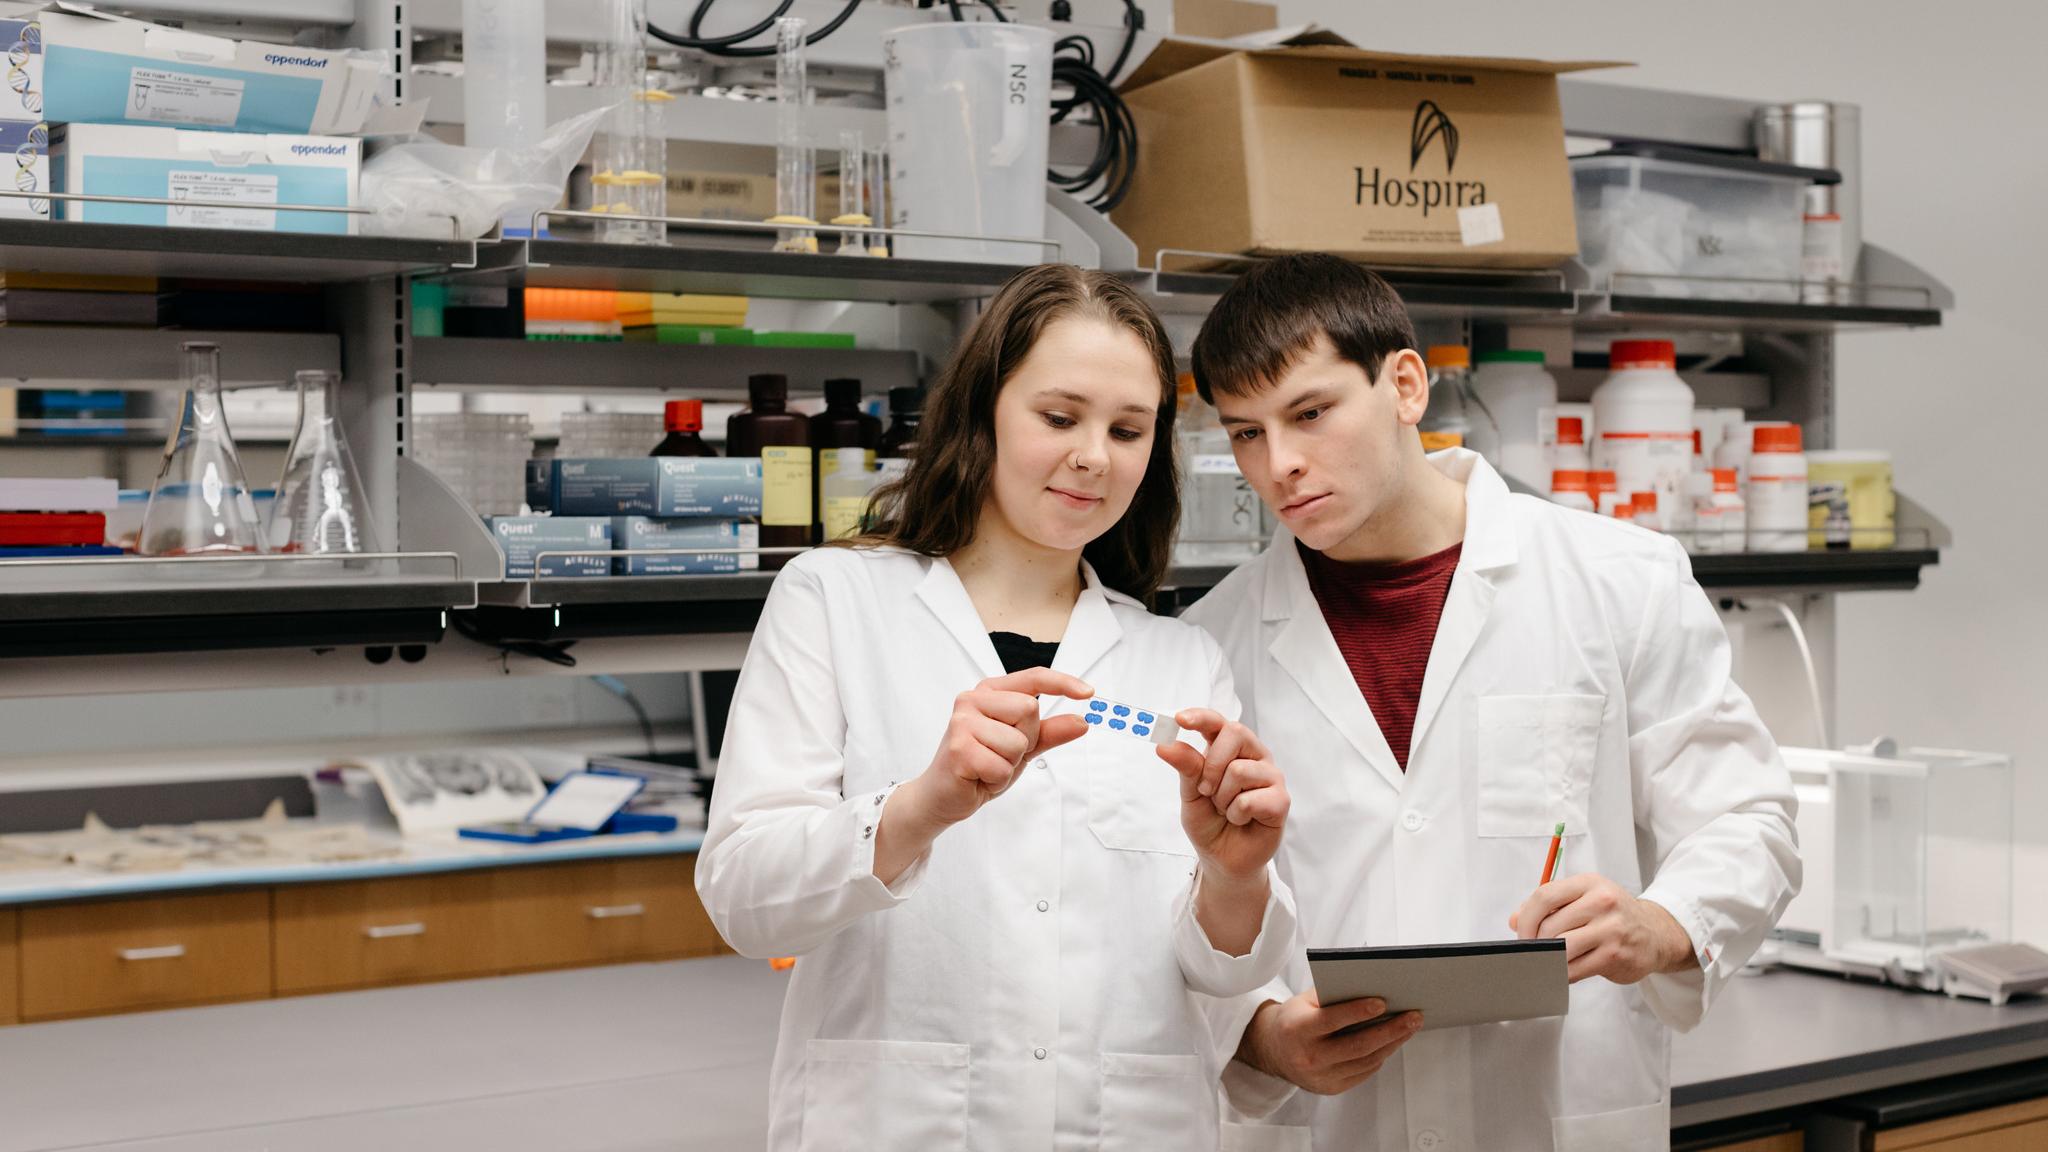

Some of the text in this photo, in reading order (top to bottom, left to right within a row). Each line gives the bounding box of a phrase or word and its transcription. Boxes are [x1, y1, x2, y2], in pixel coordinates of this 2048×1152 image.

[265, 53, 329, 69] eppendorf
[1009, 64, 1027, 104] NSC
[291, 143, 347, 158] eppendorf
[1354, 167, 1486, 218] Hospira
[664, 462, 754, 477] Quest L
[499, 522, 534, 536] Quest
[590, 524, 602, 539] M
[635, 521, 730, 536] Quest S
